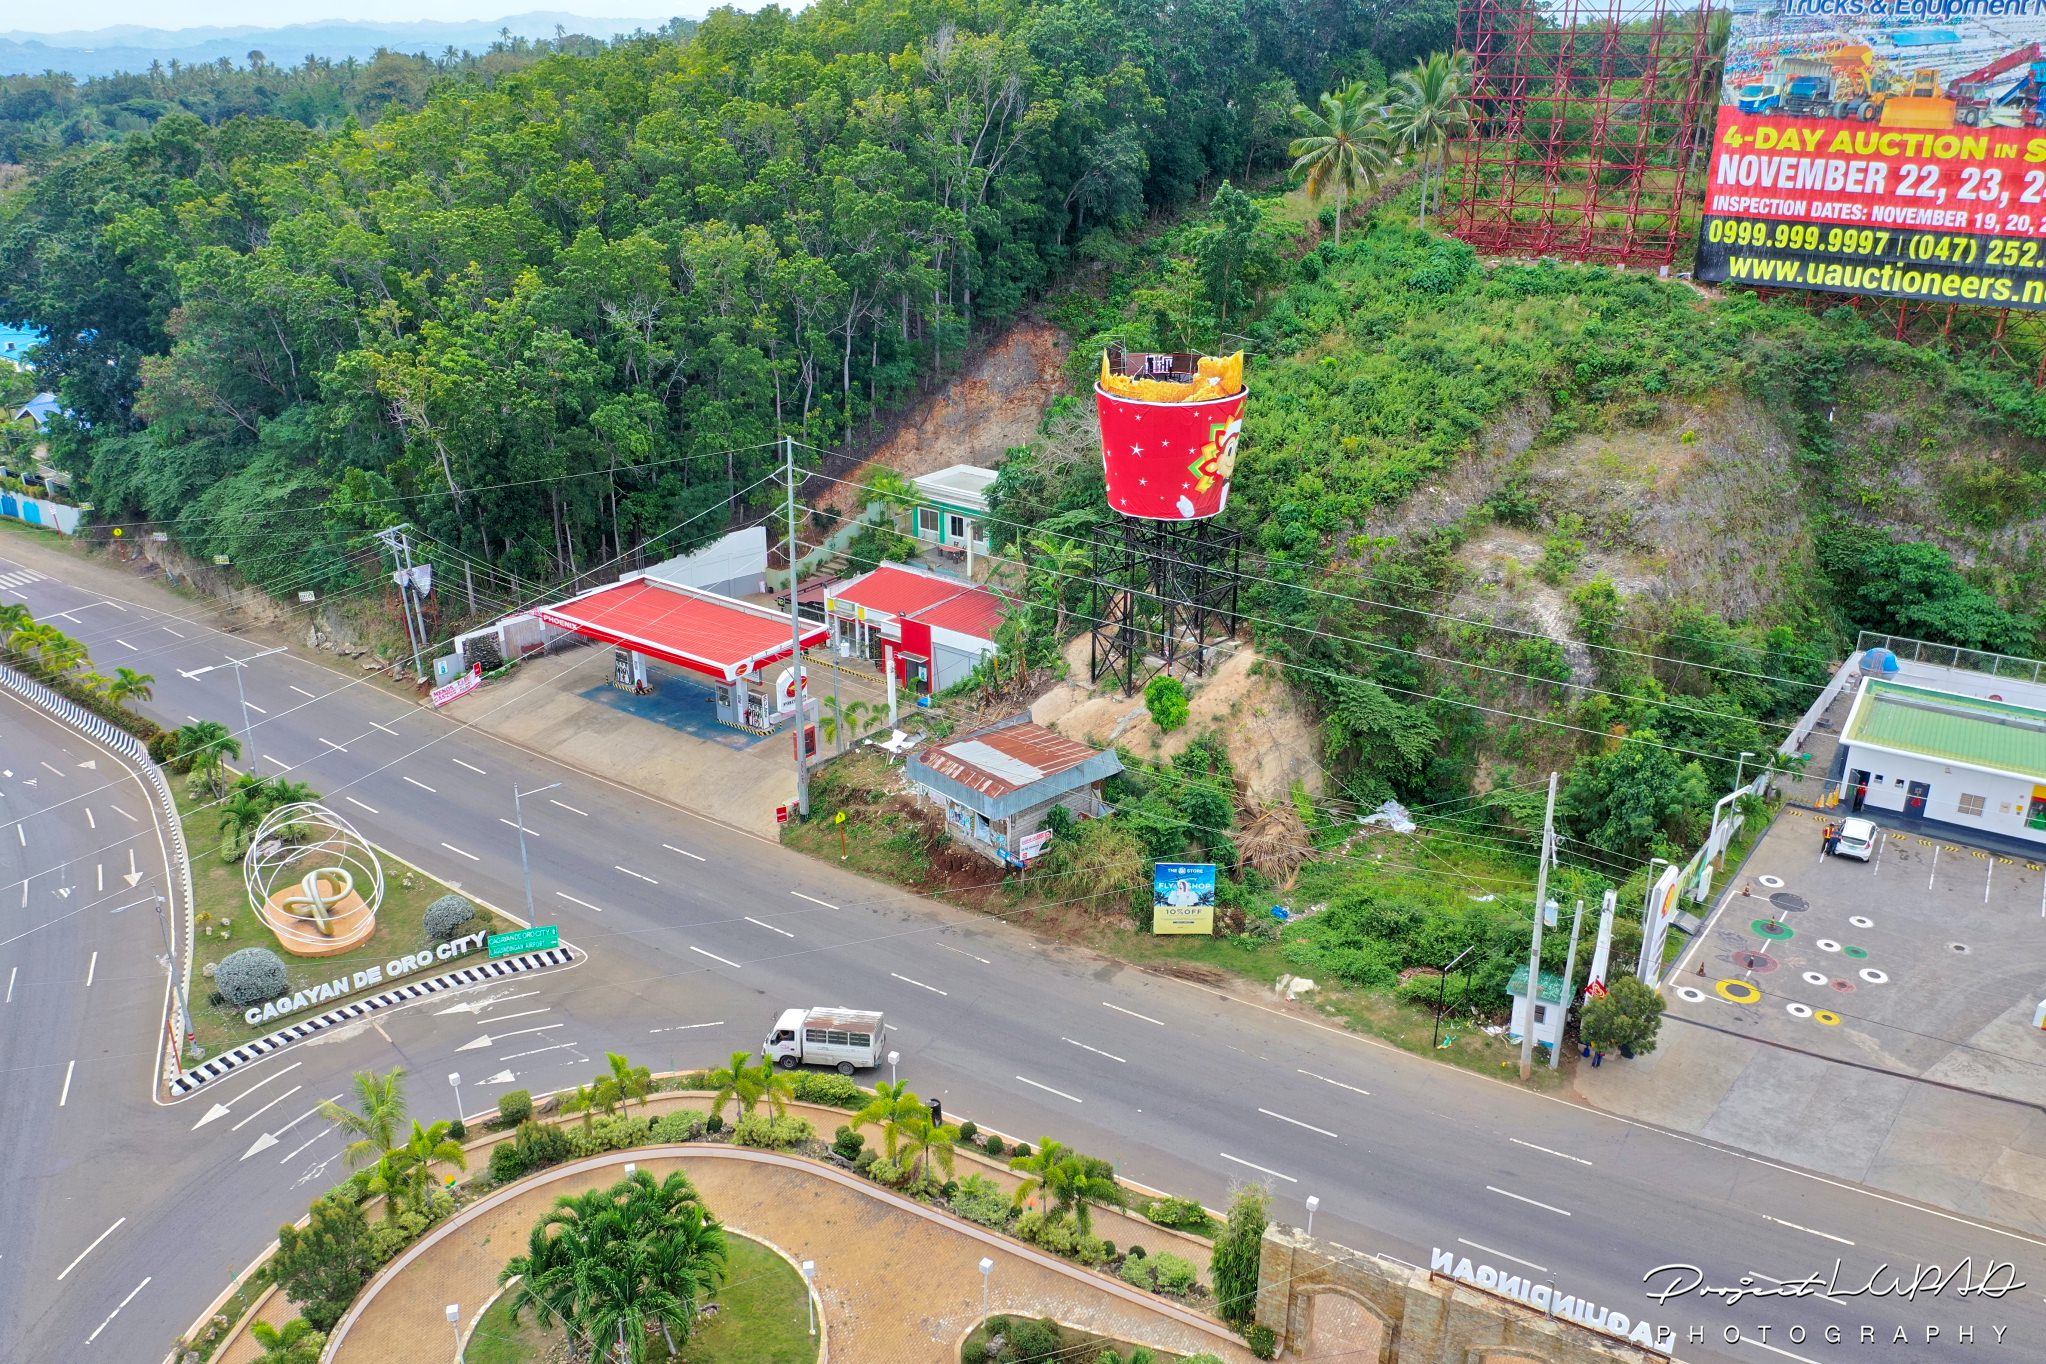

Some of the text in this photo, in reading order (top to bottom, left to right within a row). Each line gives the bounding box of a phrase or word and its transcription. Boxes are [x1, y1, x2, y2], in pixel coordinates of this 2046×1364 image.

[1893, 0, 2028, 21] Equipment
[1723, 125, 1824, 152] 4-DAY
[1828, 130, 1988, 160] AUCTION
[1994, 144, 2018, 158] IN
[1716, 154, 2046, 208] NOVEMBER 22, 23, 2
[1712, 195, 1807, 216] INSPECTION
[1811, 201, 1868, 220] DATES:
[1871, 205, 1968, 228] NOVEMBER
[1975, 212, 2001, 233] 19,
[2005, 214, 2034, 236] 20,
[1708, 219, 1889, 256] 0999.999.9997
[1909, 234, 1978, 263] (047)
[1985, 239, 2044, 268] 252.
[1729, 255, 2046, 303] www.uauctioneers.n
[543, 613, 578, 631] PHOENIX
[244, 930, 488, 1025] CAGAYAN DE ORO CITY
